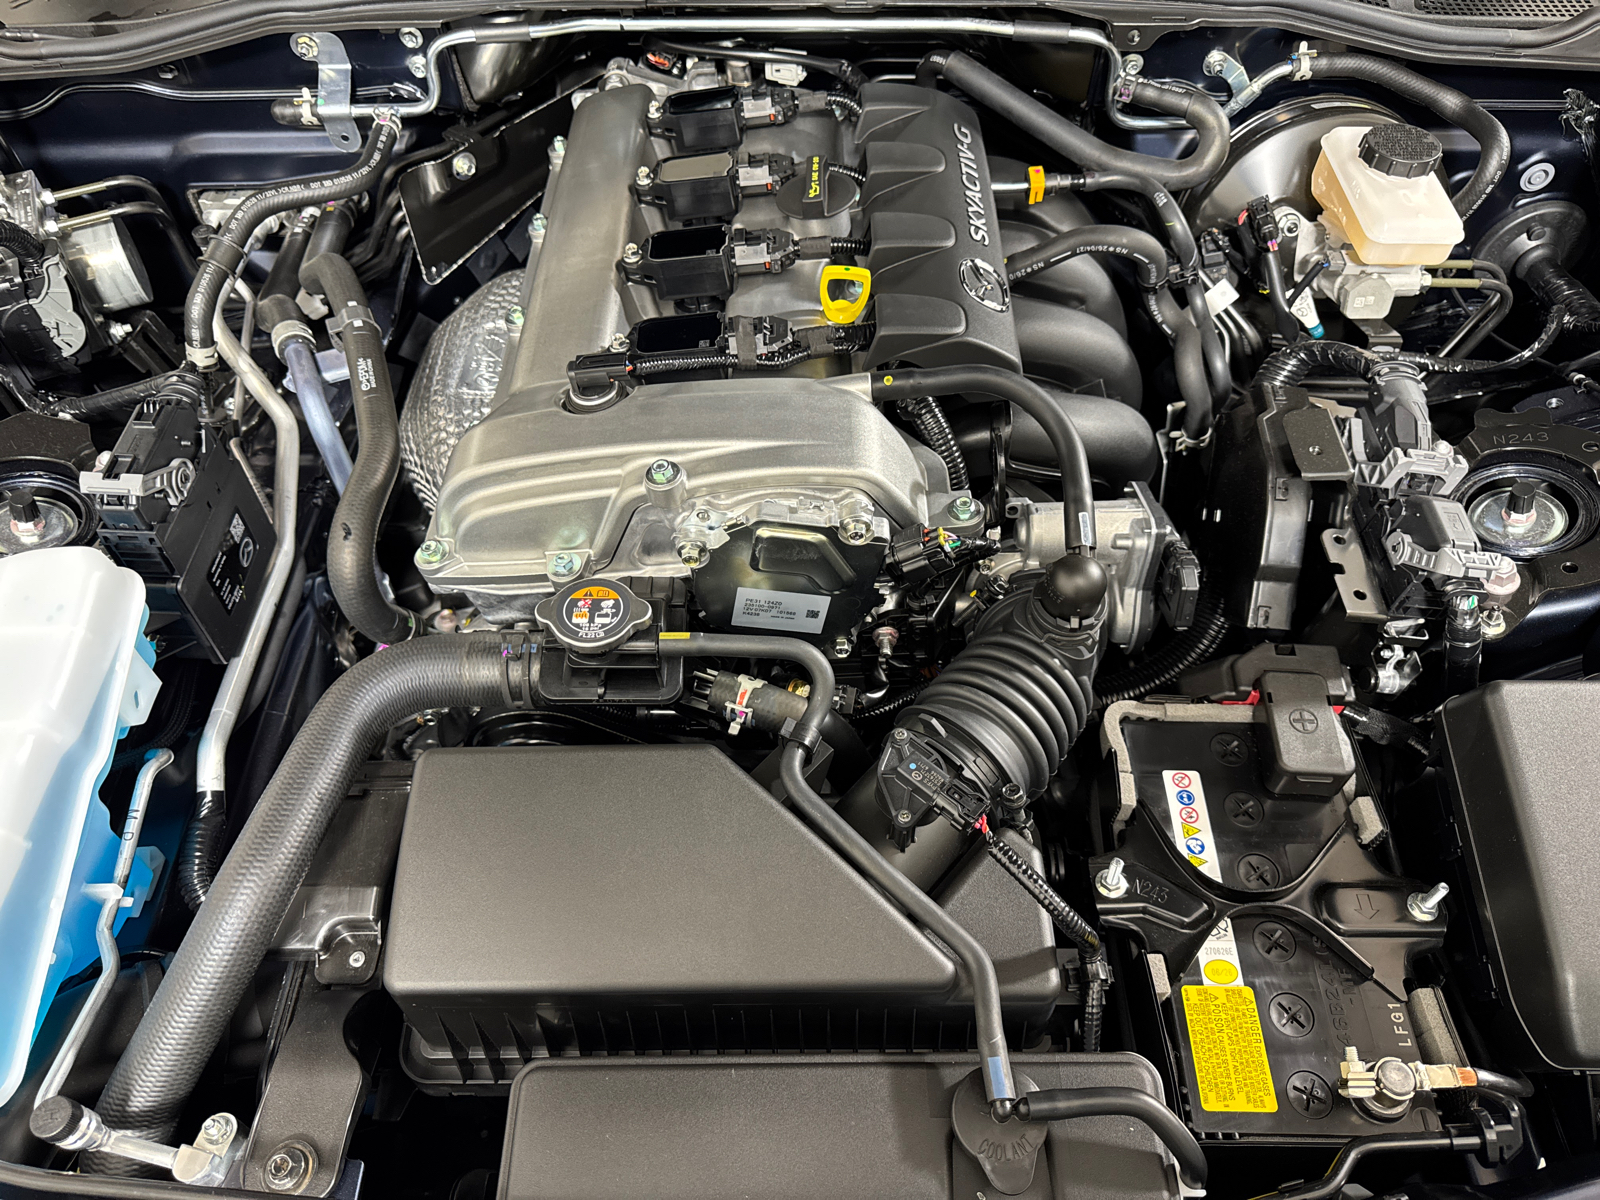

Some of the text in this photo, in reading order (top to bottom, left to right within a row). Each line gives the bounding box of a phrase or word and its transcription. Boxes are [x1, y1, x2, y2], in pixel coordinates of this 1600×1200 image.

[954, 123, 989, 246] SKYACTIV-G
[1493, 432, 1549, 445] N243
[1132, 877, 1169, 903] N243
[1192, 1003, 1200, 1016] KEEP
[1194, 1017, 1202, 1027] OUT
[1388, 1003, 1412, 1046] LFG1
[1198, 1037, 1207, 1055] REACH
[1211, 1003, 1236, 1100] POISON CAUSES SEVERE BURNS
[1220, 1002, 1244, 1094] KEEP VENT CAPS TIGHT AND LEVEL
[1246, 1007, 1271, 1096] DANGER EXPLOSIVE GASES
[1203, 1065, 1214, 1092] CHILDREN
[978, 1134, 1034, 1161] COOLANT
